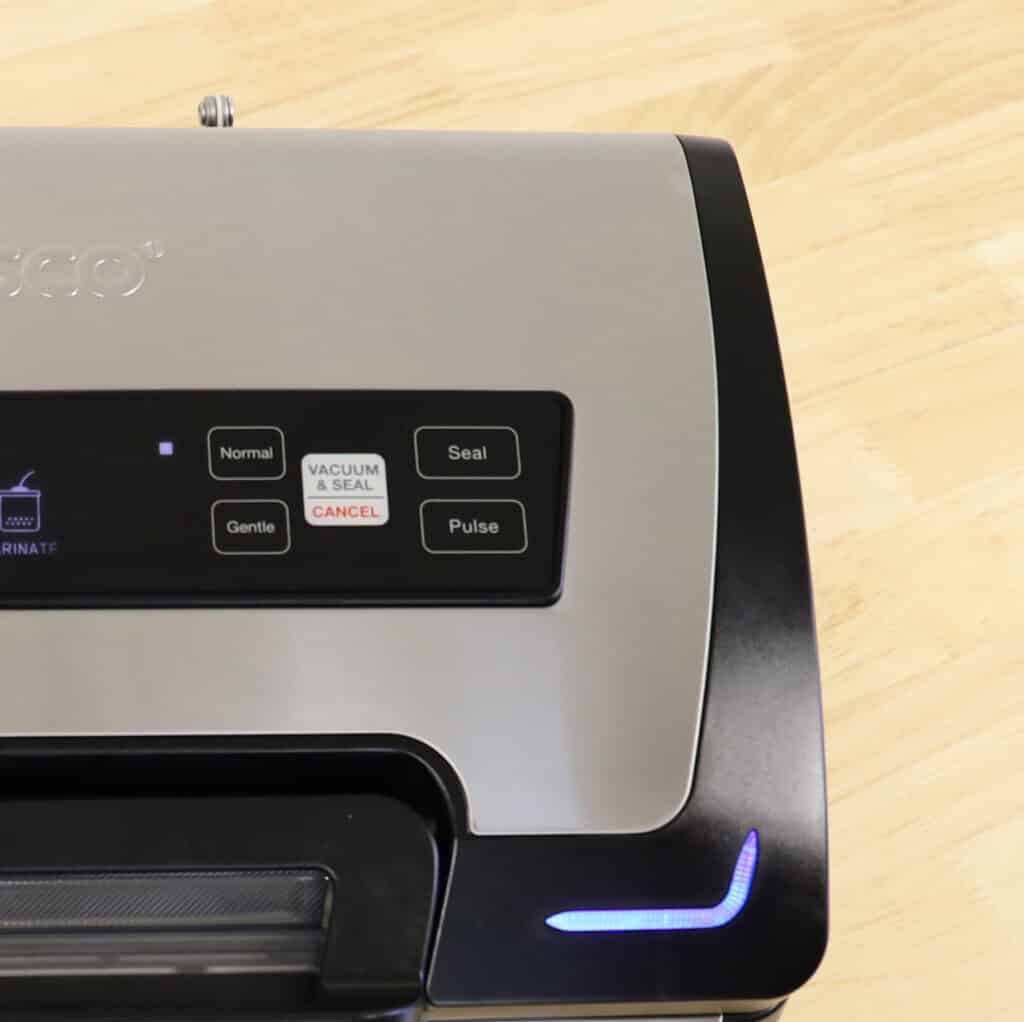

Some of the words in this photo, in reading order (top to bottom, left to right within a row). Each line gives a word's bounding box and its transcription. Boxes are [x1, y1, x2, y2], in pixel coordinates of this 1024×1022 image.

[220, 446, 274, 461] Normal
[447, 444, 488, 460] Seal
[308, 463, 380, 477] VACUUM
[316, 479, 328, 492] &
[332, 479, 374, 492] SEAL
[311, 505, 380, 519] CANCEL
[226, 520, 276, 534] Gentle
[448, 519, 500, 535] Pulse
